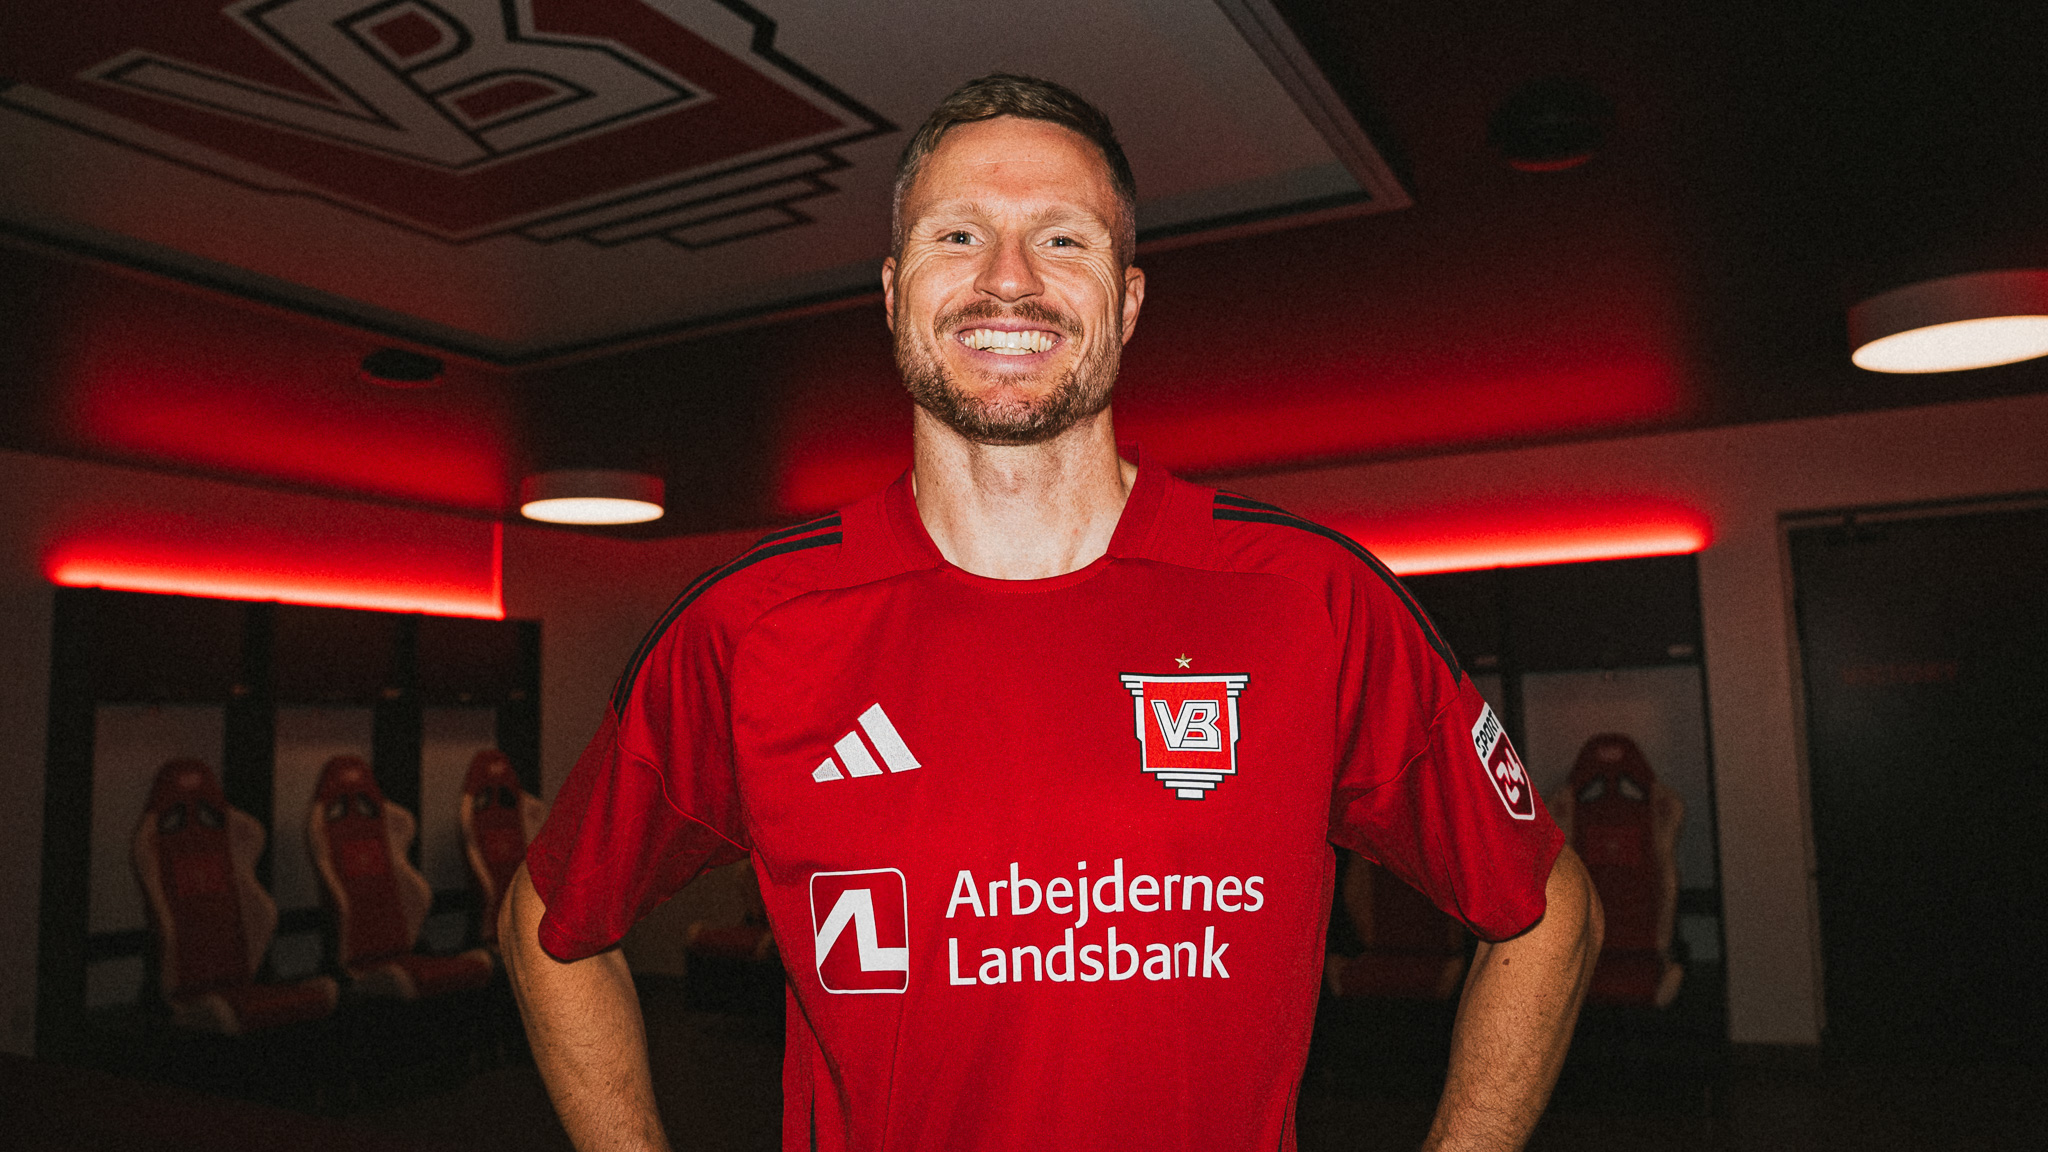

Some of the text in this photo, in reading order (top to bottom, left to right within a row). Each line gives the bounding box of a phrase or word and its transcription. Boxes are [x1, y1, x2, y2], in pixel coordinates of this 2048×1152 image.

[1150, 699, 1222, 752] VB
[1475, 709, 1501, 759] SPORT
[1495, 747, 1525, 804] 24
[945, 858, 1264, 929] Arbejdernes
[948, 926, 1230, 986] Landsbank
